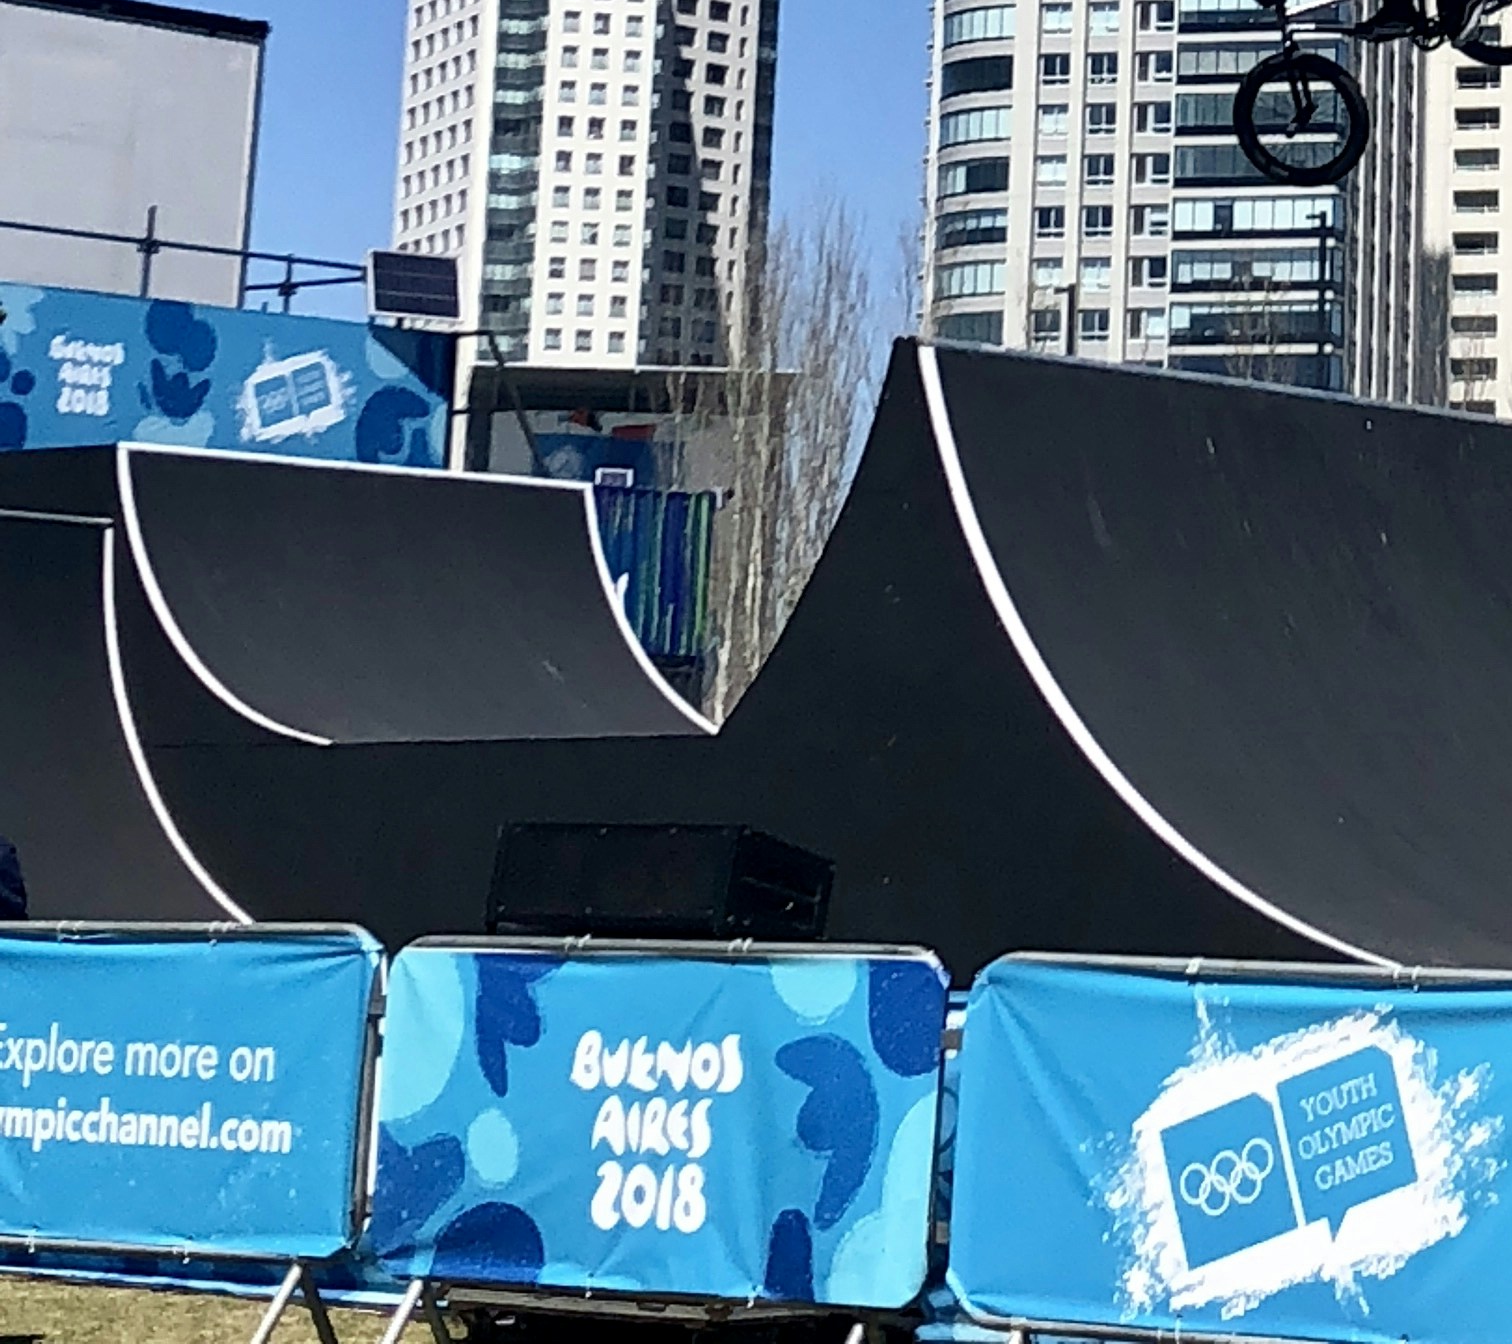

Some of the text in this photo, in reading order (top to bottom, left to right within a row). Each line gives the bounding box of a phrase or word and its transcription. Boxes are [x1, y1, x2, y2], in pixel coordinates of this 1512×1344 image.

[124, 1042, 219, 1080] more
[229, 1045, 275, 1082] on
[569, 1029, 743, 1093] BUENOS
[0, 1096, 292, 1154] mpicchannel.com
[591, 1094, 713, 1158] AIRES
[1299, 1072, 1378, 1123] YOUTH
[1298, 1102, 1395, 1160] OLYMPIC
[1314, 1141, 1394, 1190] GAMES
[591, 1160, 706, 1234] 2018
